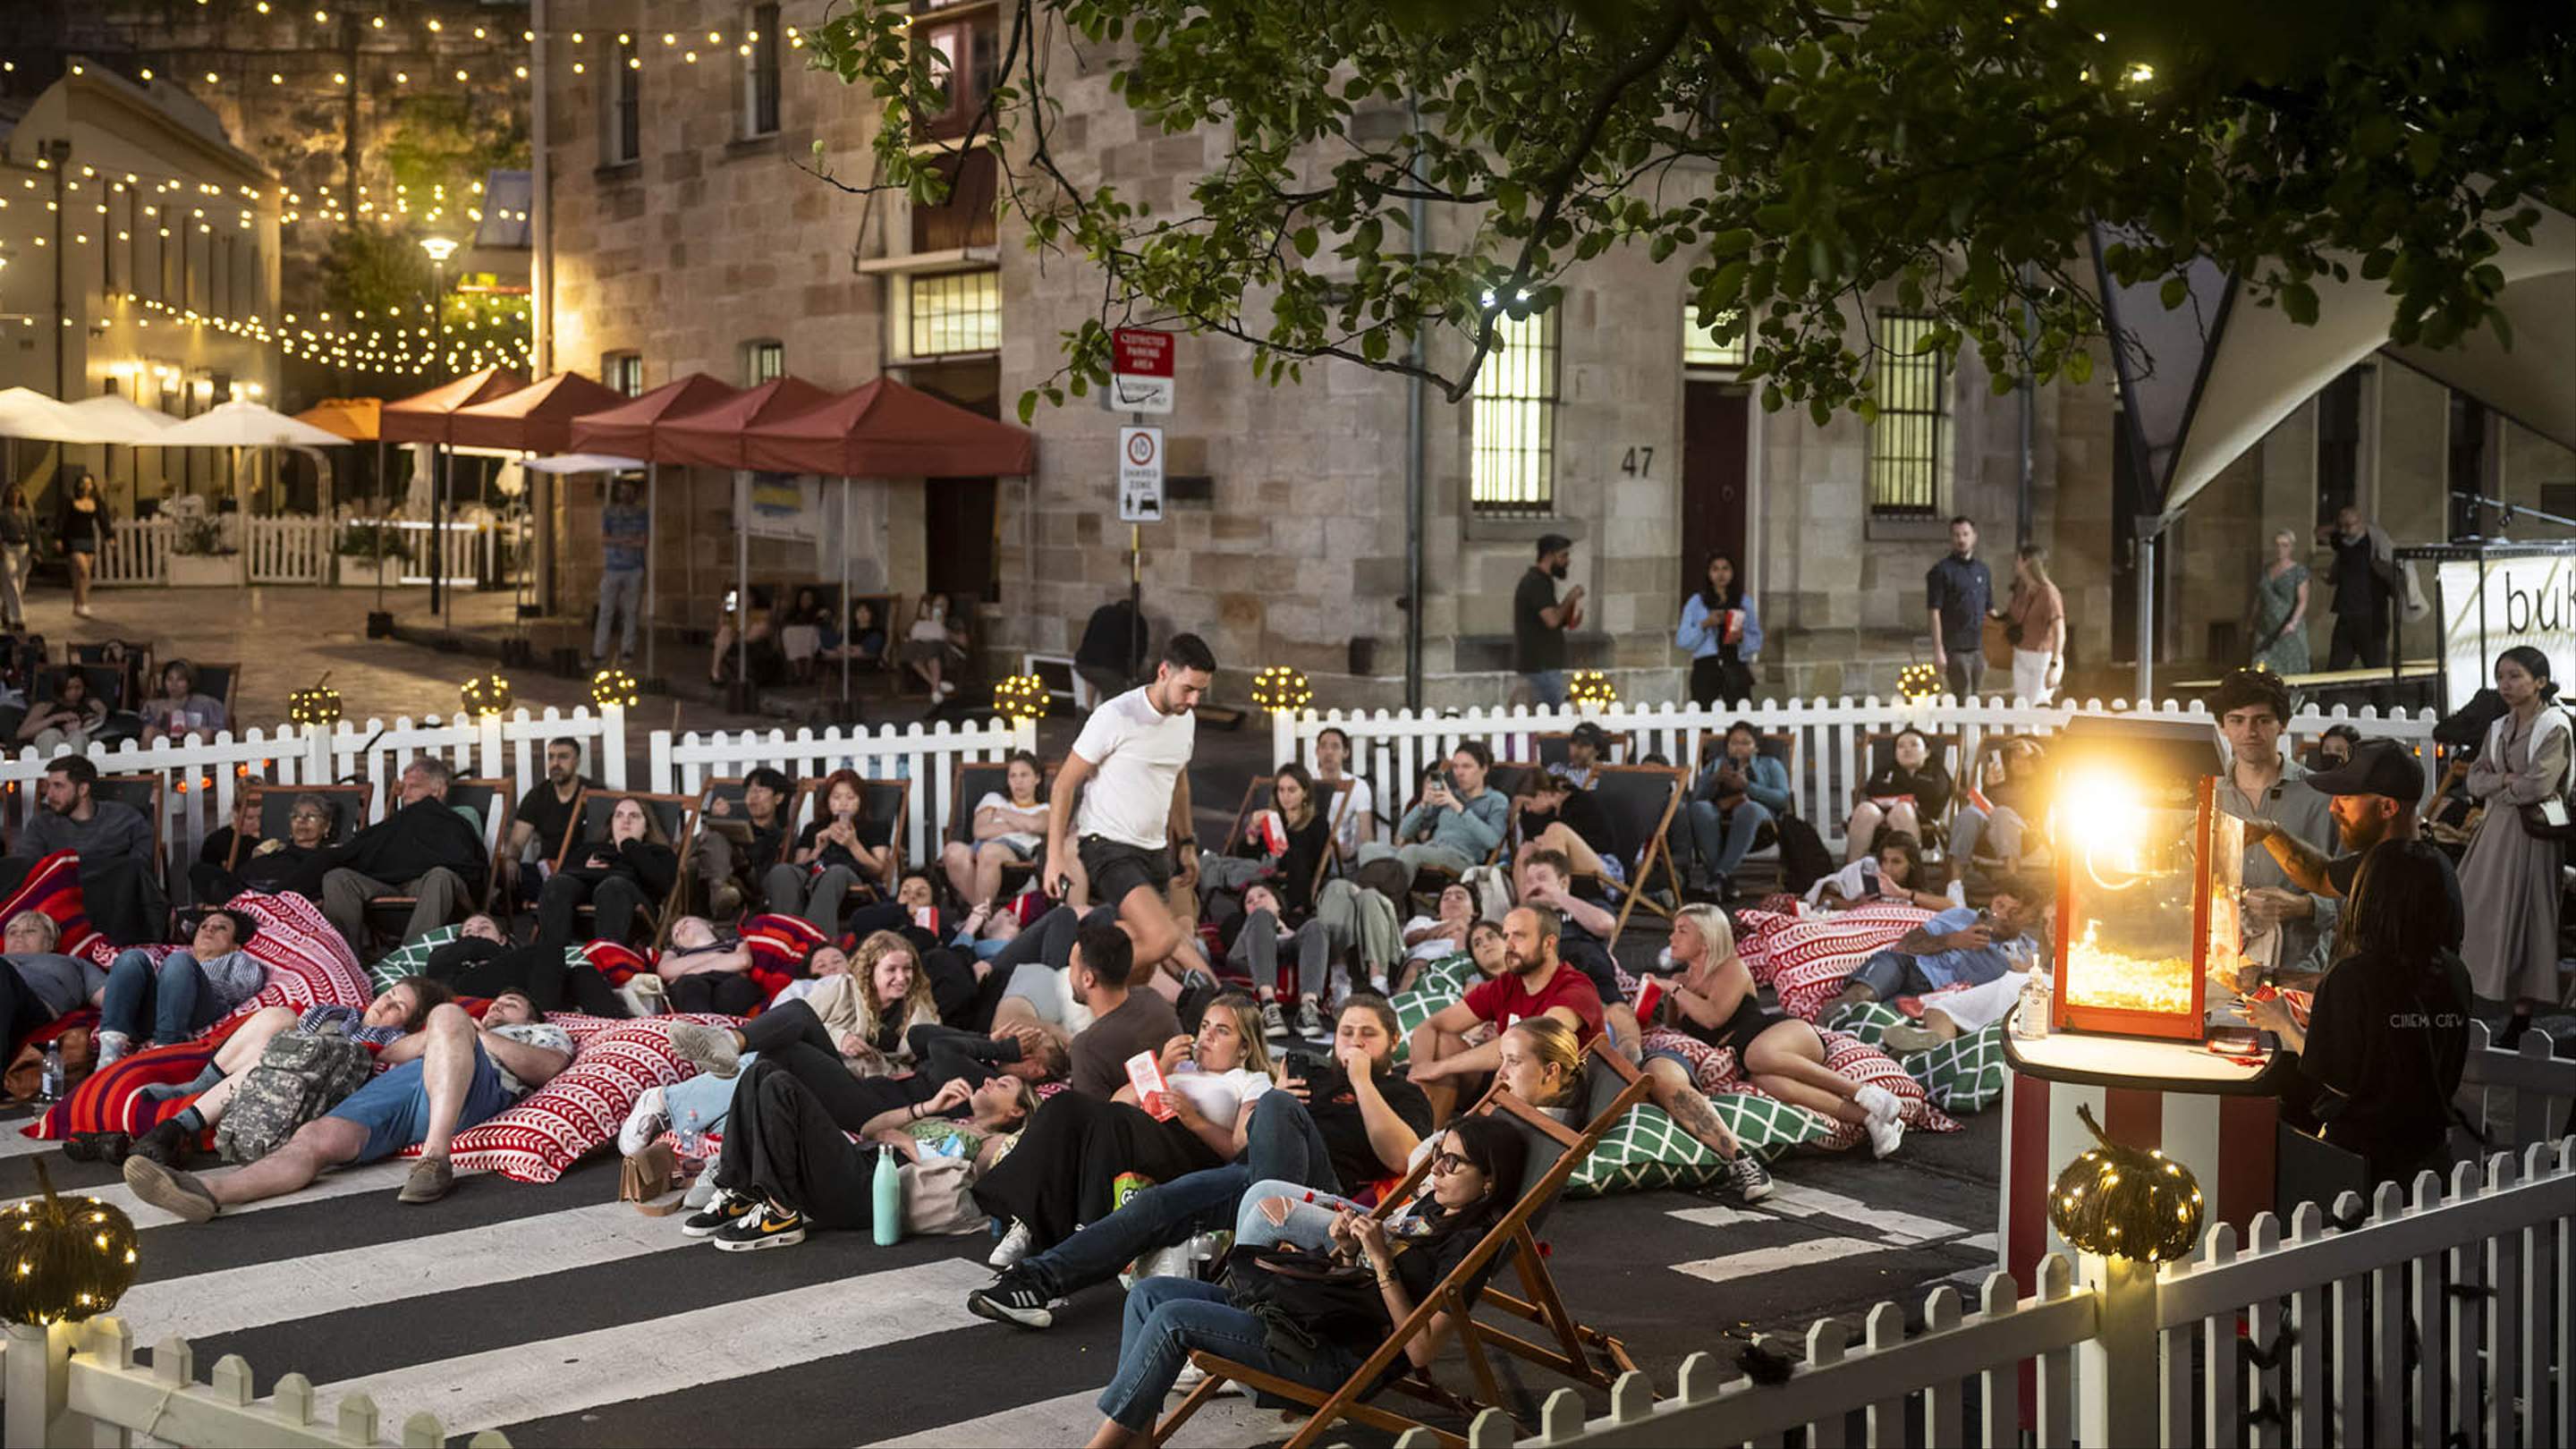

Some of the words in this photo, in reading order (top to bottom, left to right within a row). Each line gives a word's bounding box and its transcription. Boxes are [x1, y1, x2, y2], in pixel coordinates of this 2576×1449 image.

[1127, 345, 1160, 359] PARKING
[1132, 359, 1154, 369] AREA
[1134, 438, 1148, 457] 10
[1622, 446, 1654, 478] 47
[1130, 480, 1151, 490] ZONE
